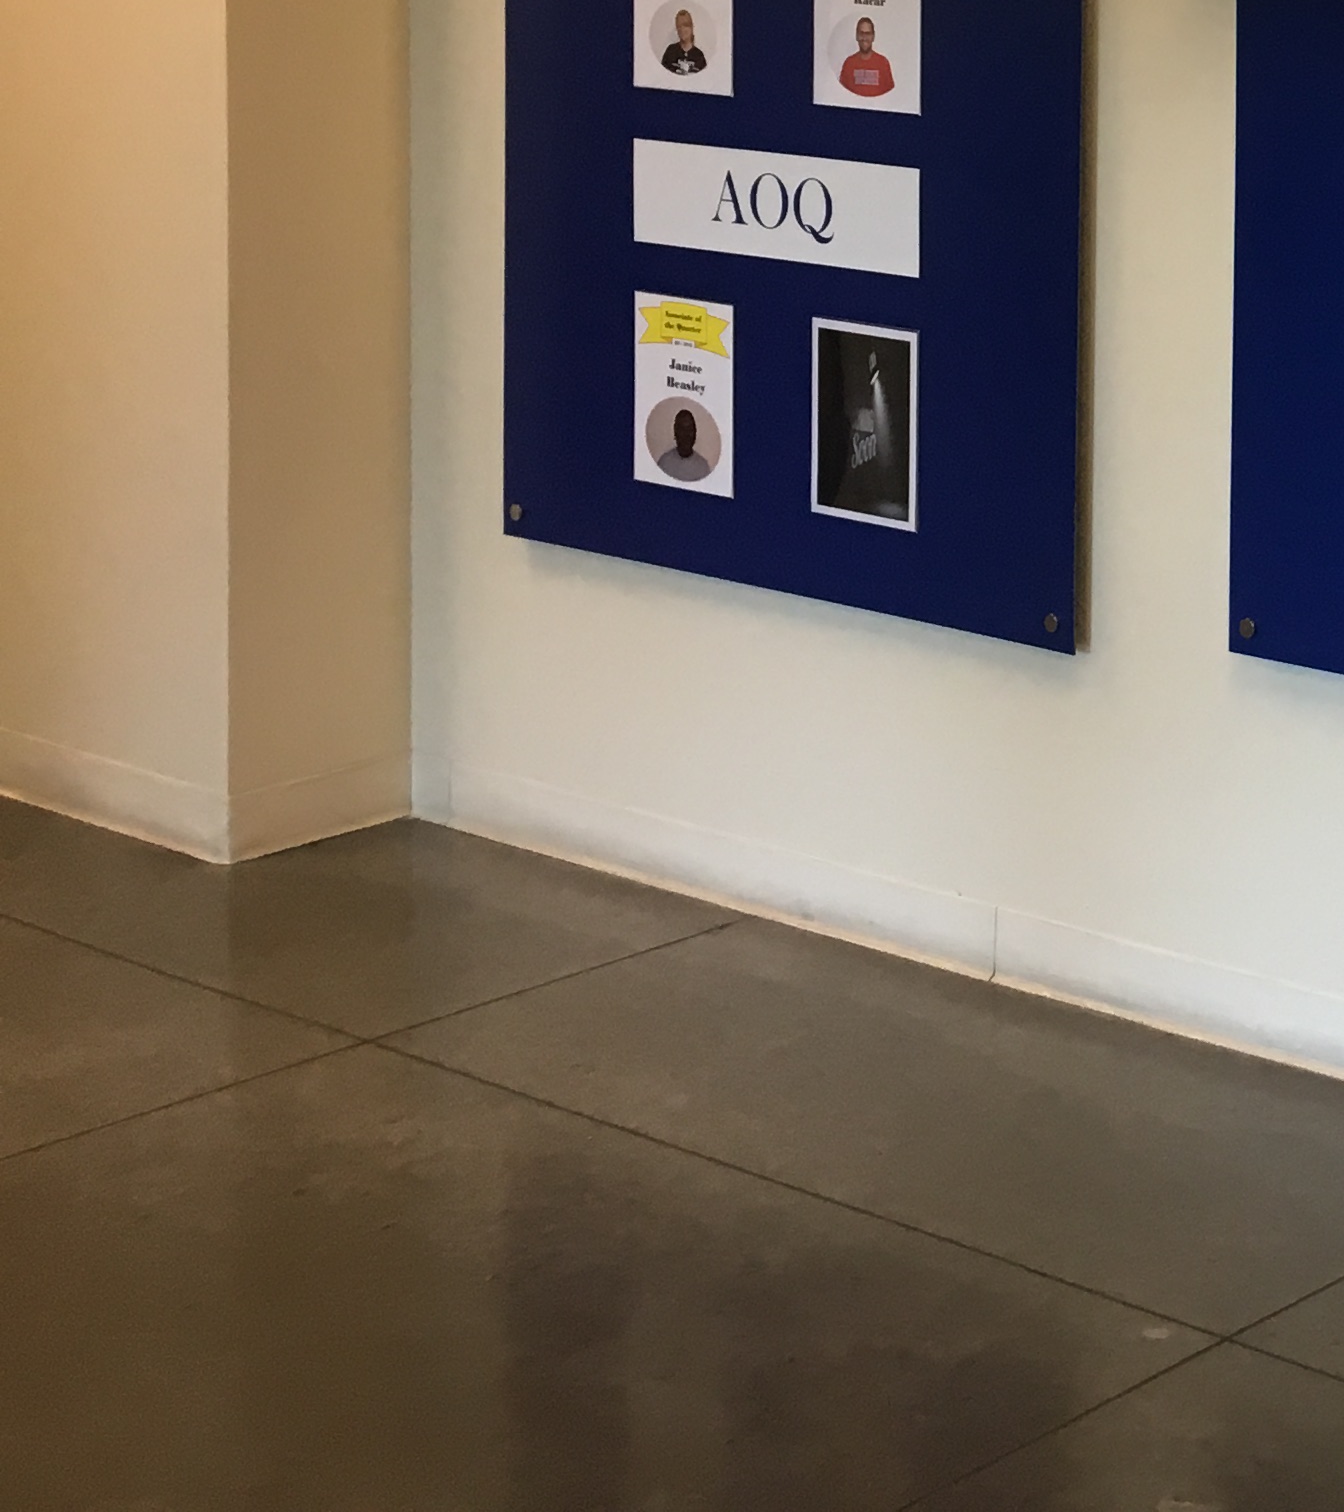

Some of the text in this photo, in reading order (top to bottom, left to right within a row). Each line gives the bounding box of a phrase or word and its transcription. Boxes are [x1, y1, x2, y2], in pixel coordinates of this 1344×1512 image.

[711, 170, 834, 244] AOQ
[669, 358, 703, 375] Janice
[666, 376, 705, 396] Beasley
